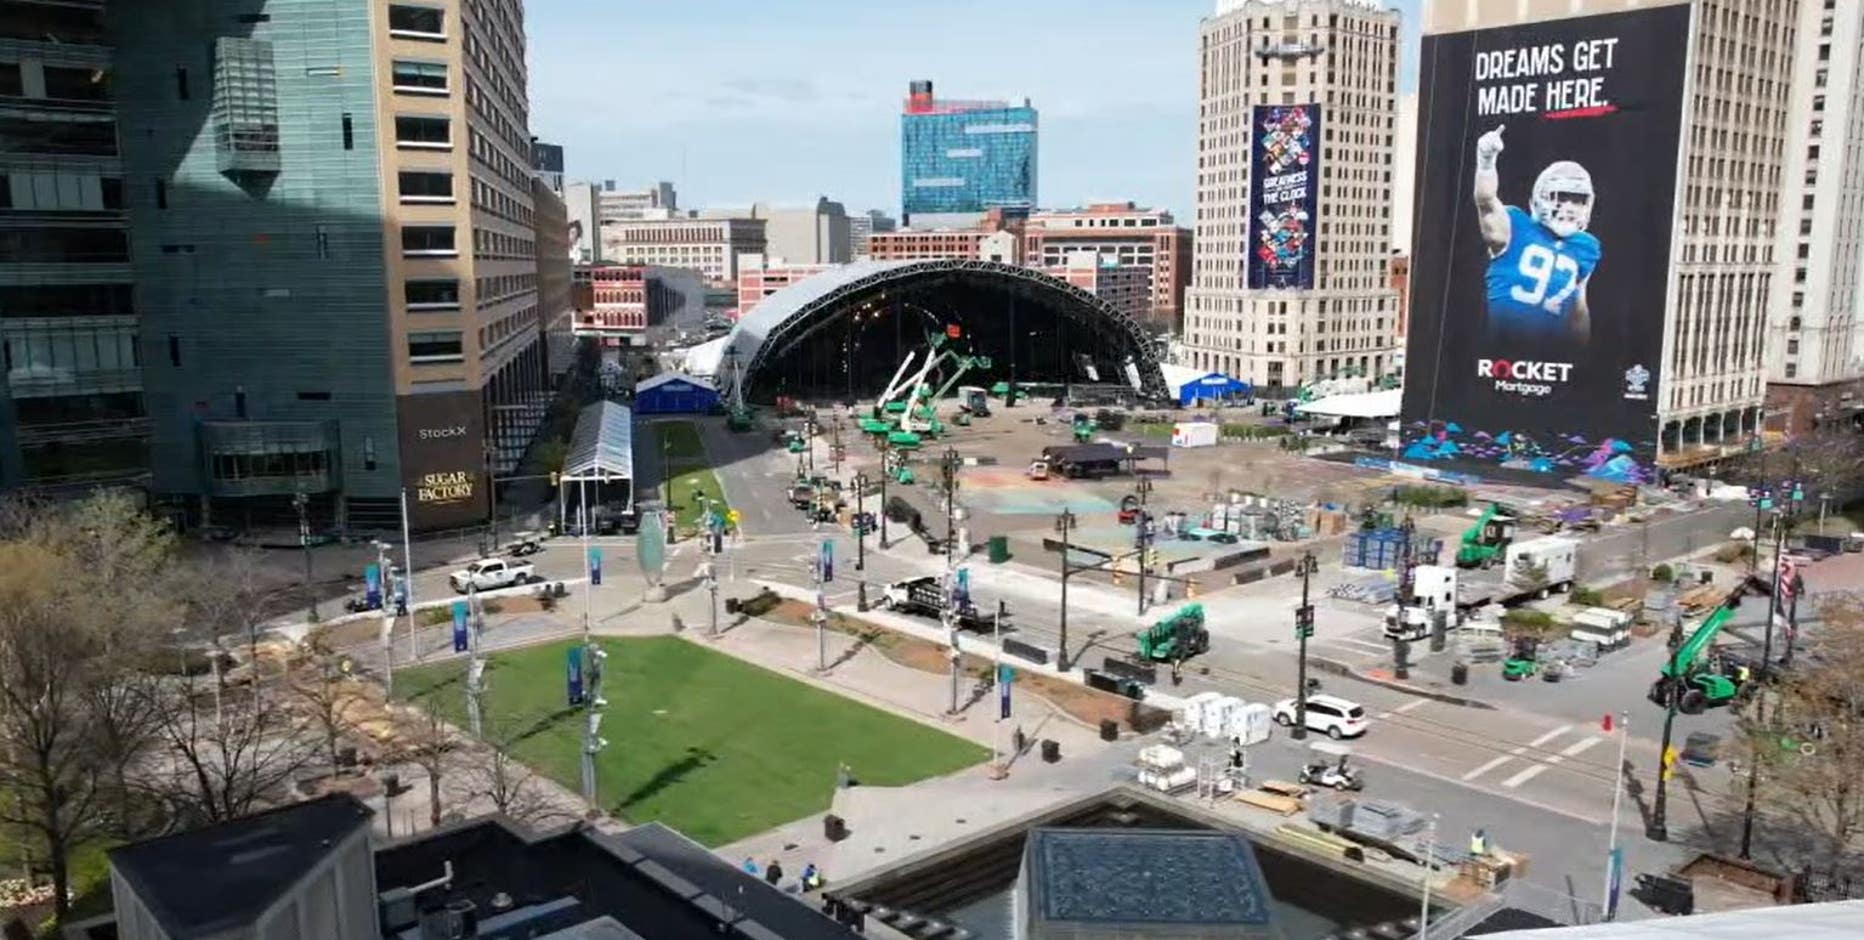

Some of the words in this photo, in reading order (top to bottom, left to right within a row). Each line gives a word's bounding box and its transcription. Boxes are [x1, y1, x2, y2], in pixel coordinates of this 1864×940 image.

[1476, 44, 1564, 81] DREAMS
[1573, 38, 1618, 72] GET
[1478, 83, 1538, 116] MADE
[1546, 78, 1609, 110] HERE.
[1263, 191, 1278, 205] THE
[1280, 187, 1307, 201] CLOCK
[1511, 243, 1579, 316] 97
[1478, 359, 1573, 382] ROCKET
[1495, 380, 1551, 396] Mortgage
[419, 426, 467, 440] StockX
[424, 471, 466, 487] SUGAR
[417, 483, 473, 501] FACTORY
